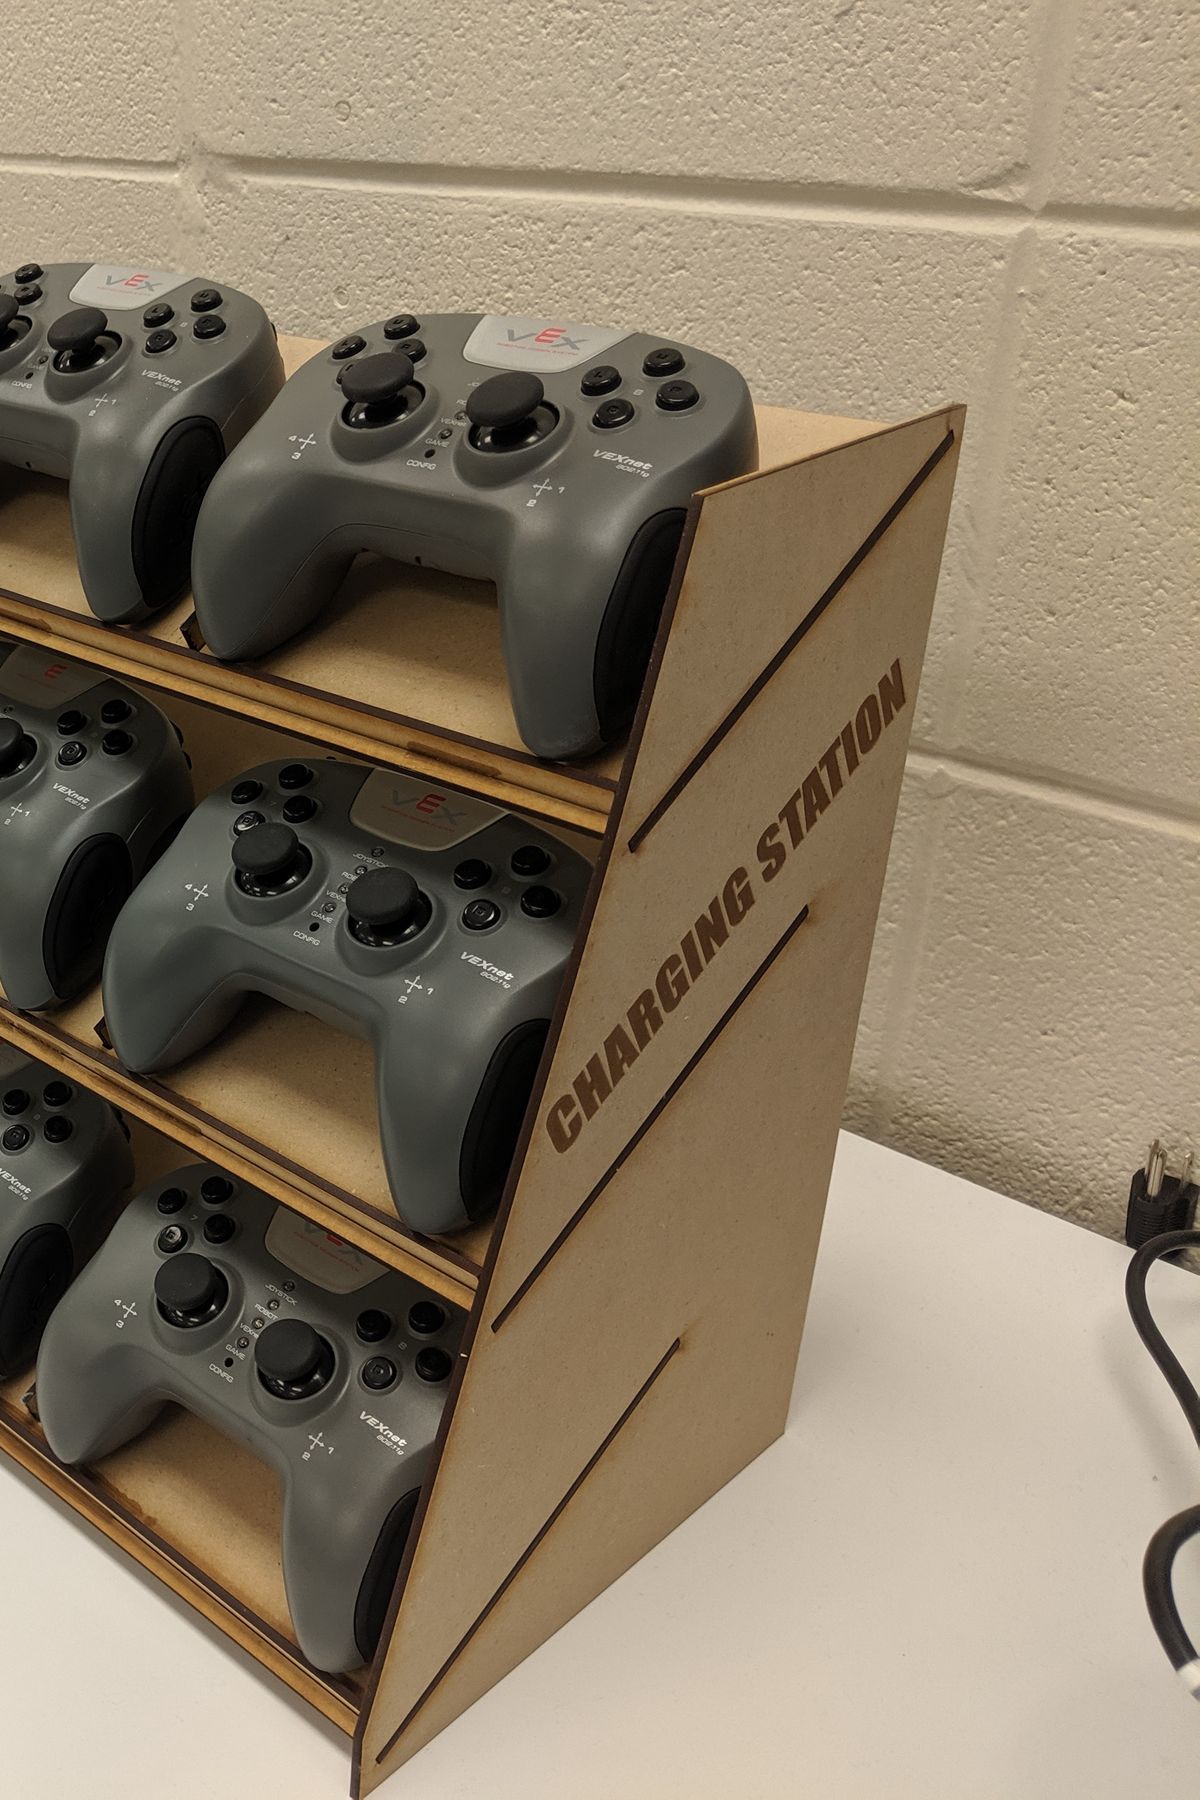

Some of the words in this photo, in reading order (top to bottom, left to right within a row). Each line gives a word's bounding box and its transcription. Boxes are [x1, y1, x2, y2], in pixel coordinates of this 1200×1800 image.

[106, 274, 162, 291] VEX
[507, 327, 592, 350] VEX
[142, 369, 182, 385] VEXnet
[291, 452, 301, 460] 3
[592, 449, 653, 470] VEXnet
[53, 782, 90, 804] VEXnet
[342, 871, 358, 881] ROB
[186, 903, 195, 911] 3
[545, 866, 756, 1154] CHARGING
[756, 657, 907, 884] STATION
[311, 910, 334, 924] GAME
[293, 930, 321, 946] CONFIG
[460, 951, 514, 981] VEXnet
[398, 995, 408, 1005] 2
[265, 1284, 298, 1307] JOYSTICK
[254, 1303, 278, 1321] ROBOT
[115, 1319, 125, 1329] 3
[225, 1344, 246, 1361] GAME
[209, 1363, 234, 1383] CONFIG
[360, 1410, 408, 1447] VEXnet
[302, 1451, 311, 1461] 2
[328, 1446, 335, 1455] 1
